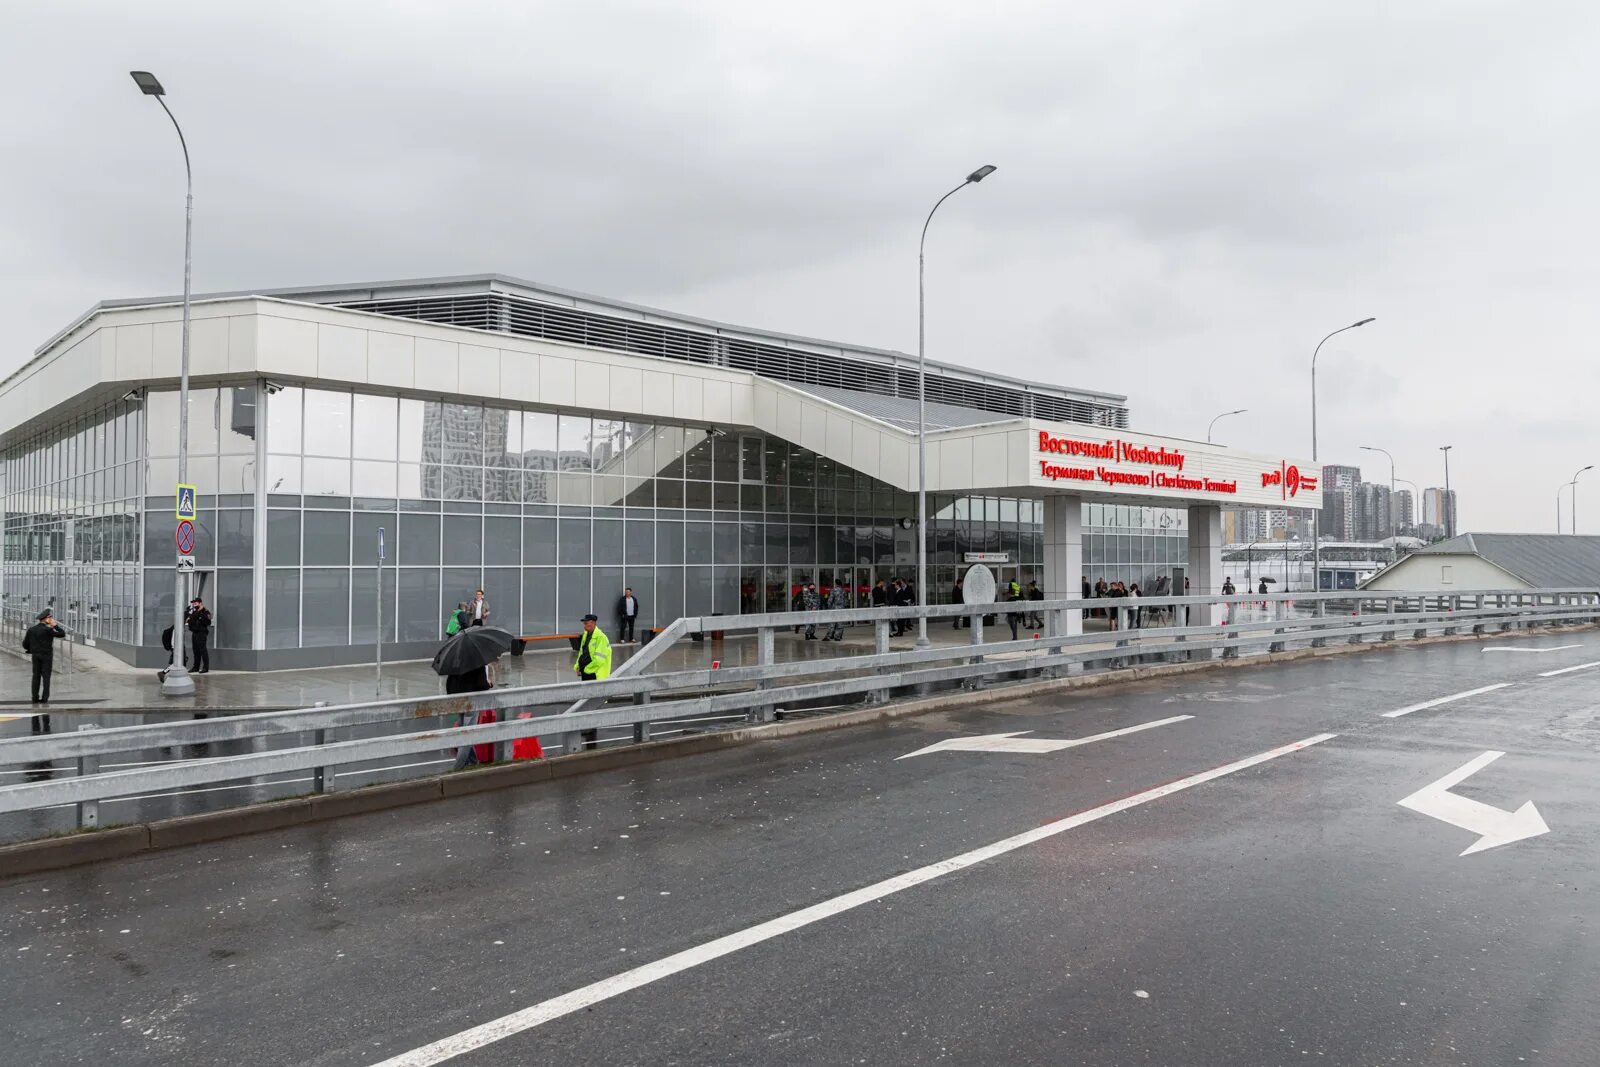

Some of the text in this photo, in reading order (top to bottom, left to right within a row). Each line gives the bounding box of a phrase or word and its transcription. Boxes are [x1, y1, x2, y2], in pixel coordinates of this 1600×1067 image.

[1039, 431, 1115, 459] Восточный
[1122, 442, 1185, 471] Vostochniy
[1039, 460, 1150, 486] Терминал Черкизово
[1155, 472, 1237, 494] Cherkizovo Terminal
